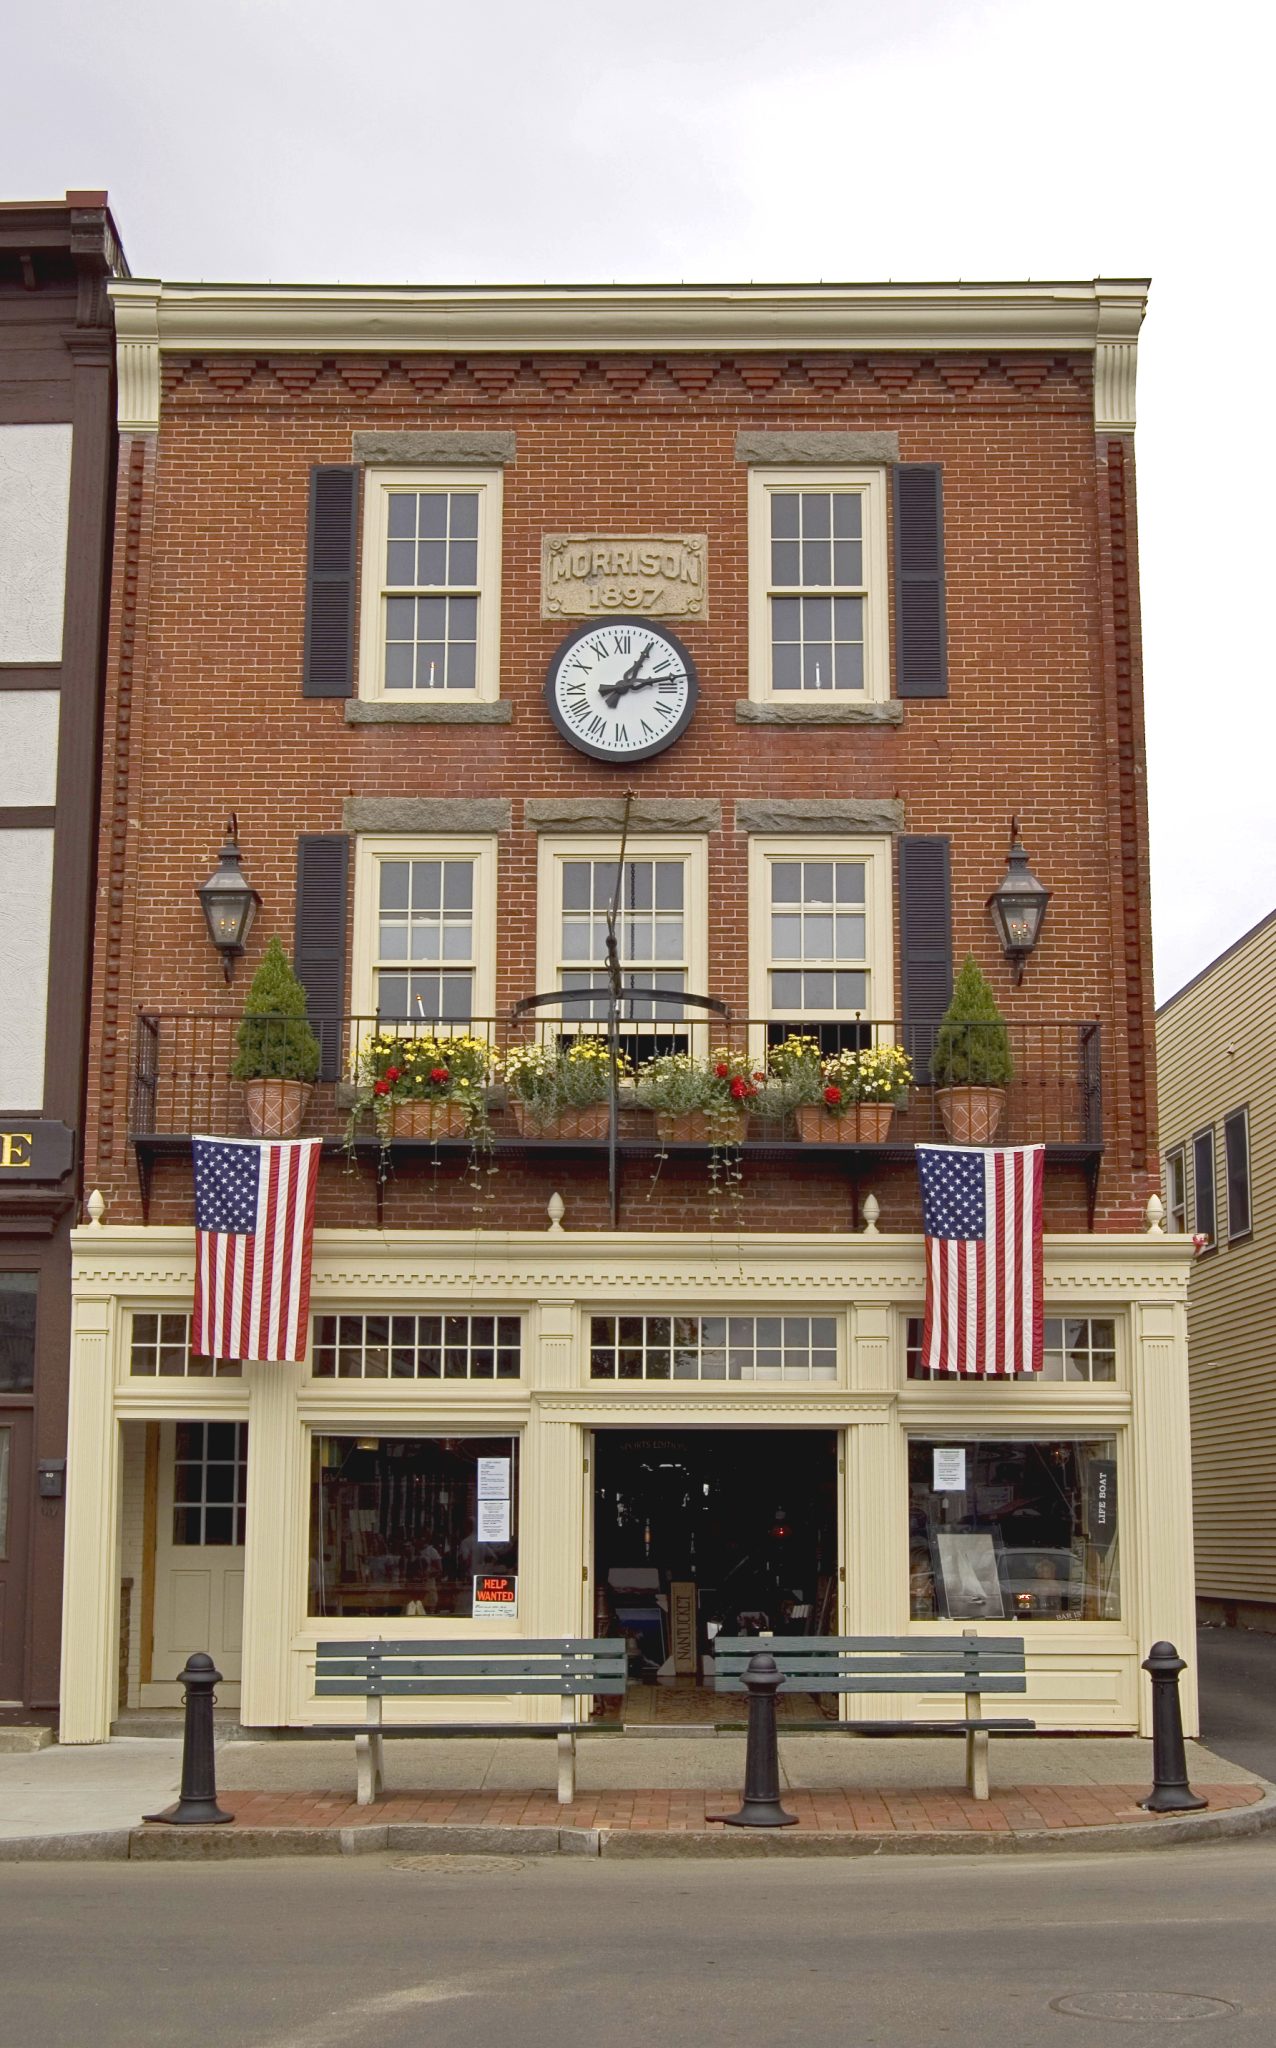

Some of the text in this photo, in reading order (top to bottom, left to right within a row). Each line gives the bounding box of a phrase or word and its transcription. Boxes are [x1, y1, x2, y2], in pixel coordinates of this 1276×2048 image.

[551, 549, 699, 585] MORRISON
[589, 584, 664, 609] 1897
[590, 640, 610, 662] XI
[614, 636, 631, 655] XII
[572, 659, 593, 676] X
[653, 659, 672, 674] II
[566, 683, 586, 695] IX
[658, 683, 678, 694] III
[569, 698, 592, 723] VIII
[653, 700, 674, 720] IV
[588, 715, 607, 738] VII
[615, 723, 629, 742] VI
[640, 718, 654, 737] V
[0, 1133, 33, 1167] E
[1098, 1472, 1107, 1525] LIFE BOAT
[484, 1579, 508, 1589] HELP
[477, 1590, 514, 1601] WANTED
[677, 1595, 691, 1660] NANTUCKET
